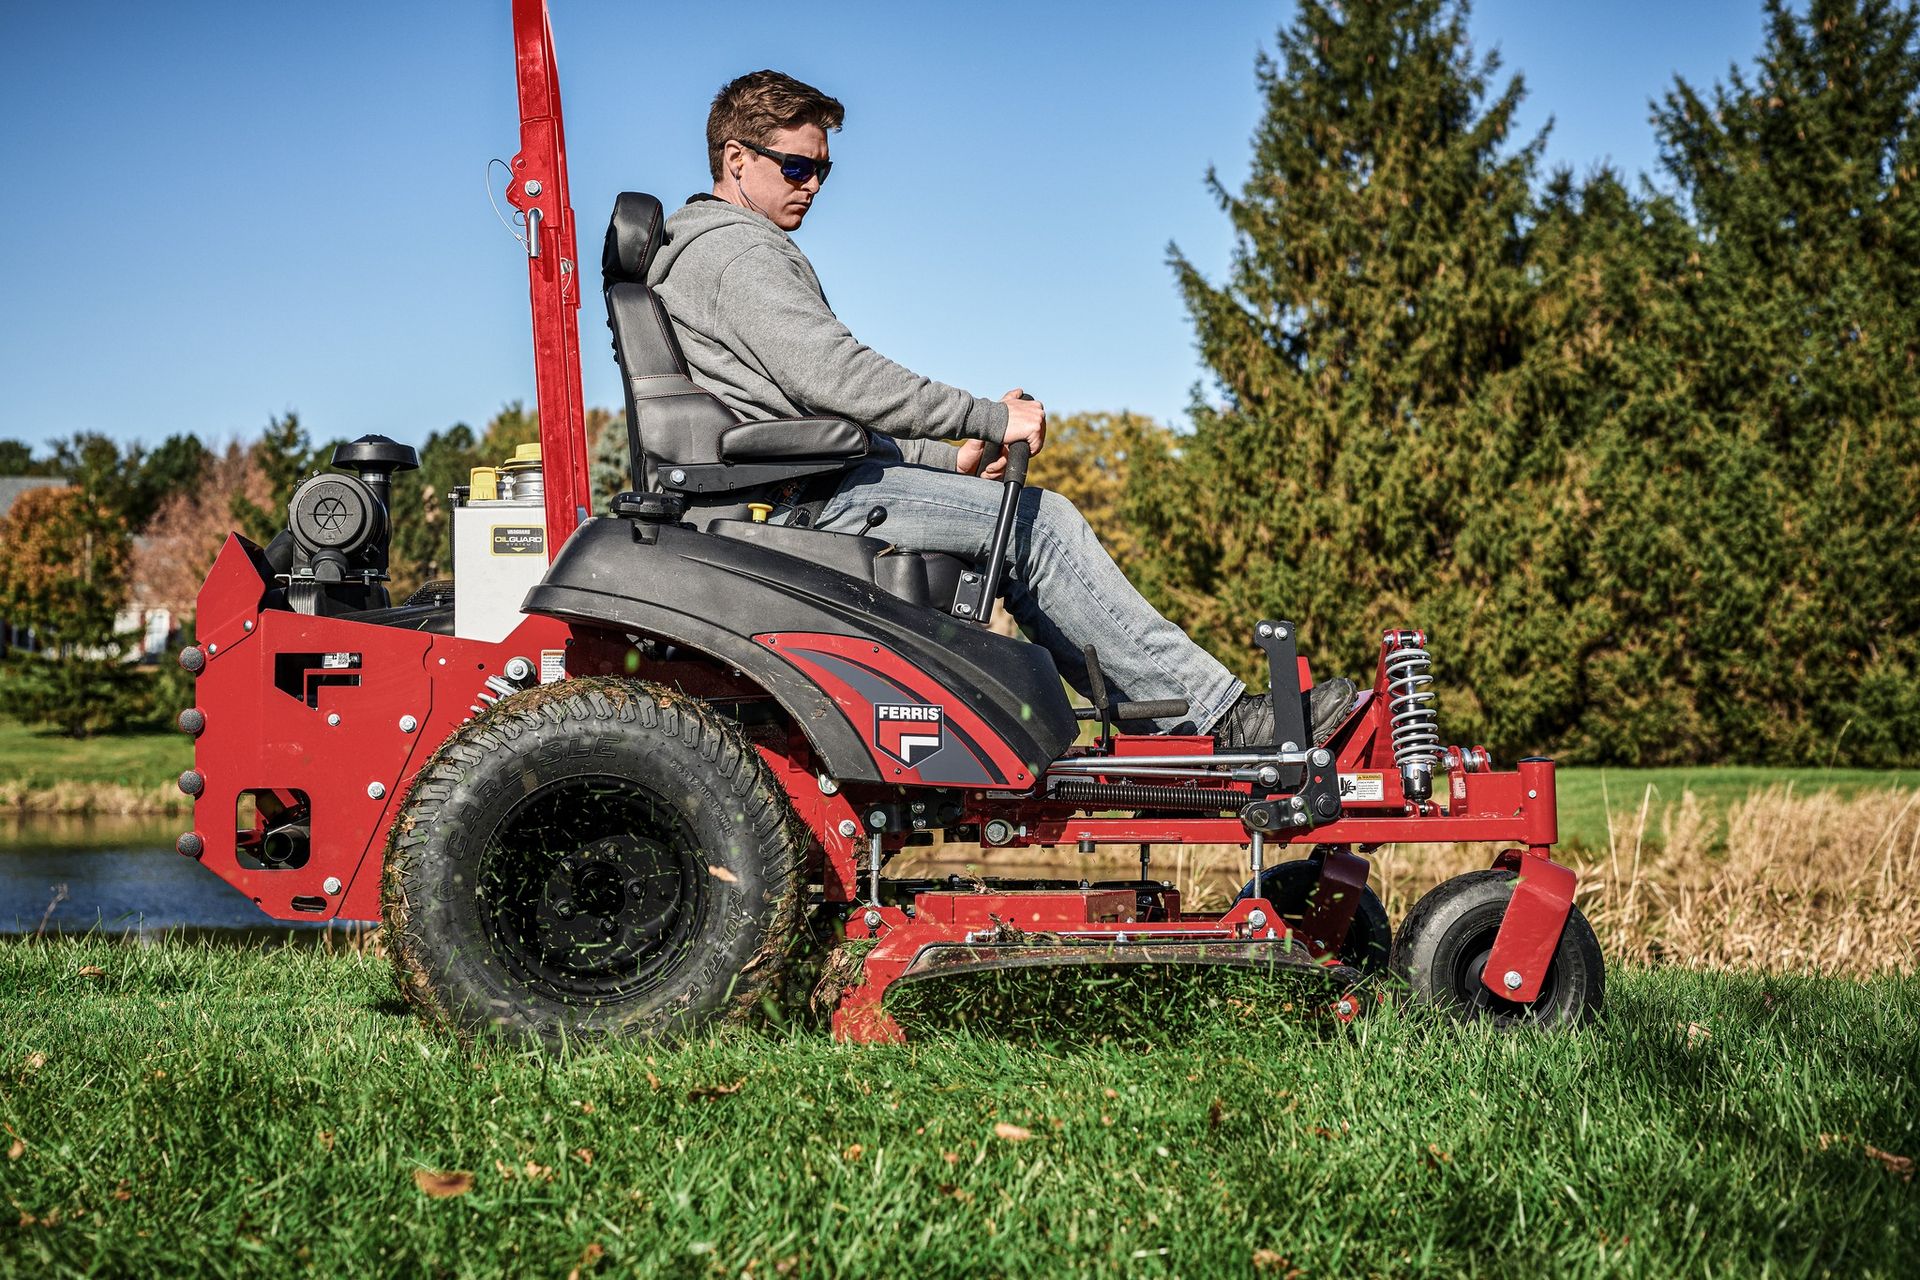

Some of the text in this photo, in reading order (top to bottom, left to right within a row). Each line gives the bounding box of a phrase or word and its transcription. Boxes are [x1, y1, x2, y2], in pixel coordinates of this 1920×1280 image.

[879, 706, 940, 720] FERRIS
[445, 737, 621, 860] CARLISLE
[702, 888, 743, 984] MULTI
